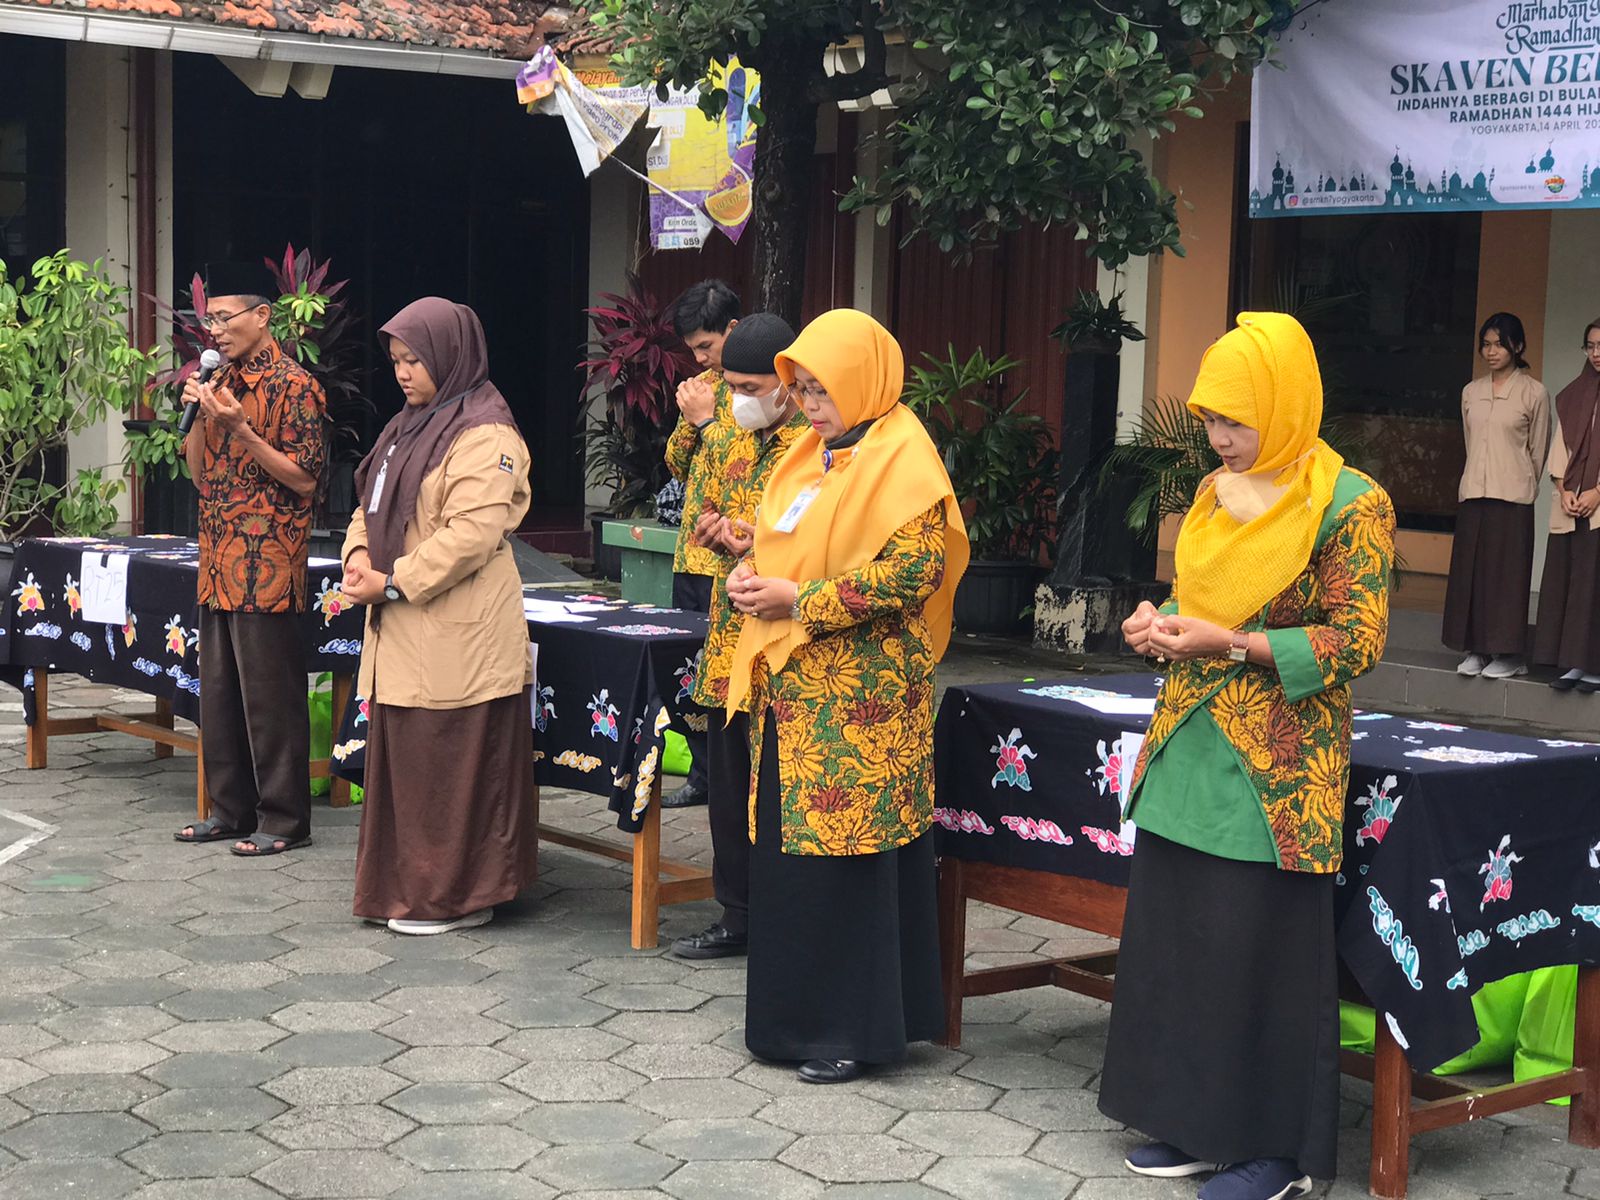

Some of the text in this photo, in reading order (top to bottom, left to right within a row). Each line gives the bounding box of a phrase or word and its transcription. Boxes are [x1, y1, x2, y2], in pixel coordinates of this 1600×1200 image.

[1496, 0, 1591, 29] Marhaban
[1390, 52, 1600, 96] SKAVEN BE
[1397, 88, 1600, 111] INDAHNYA BERBAGI DI BULA
[1450, 107, 1532, 123] RAMADHAN
[1537, 104, 1572, 118] 1444
[1553, 120, 1581, 131] APRIL
[1585, 119, 1600, 129] 20
